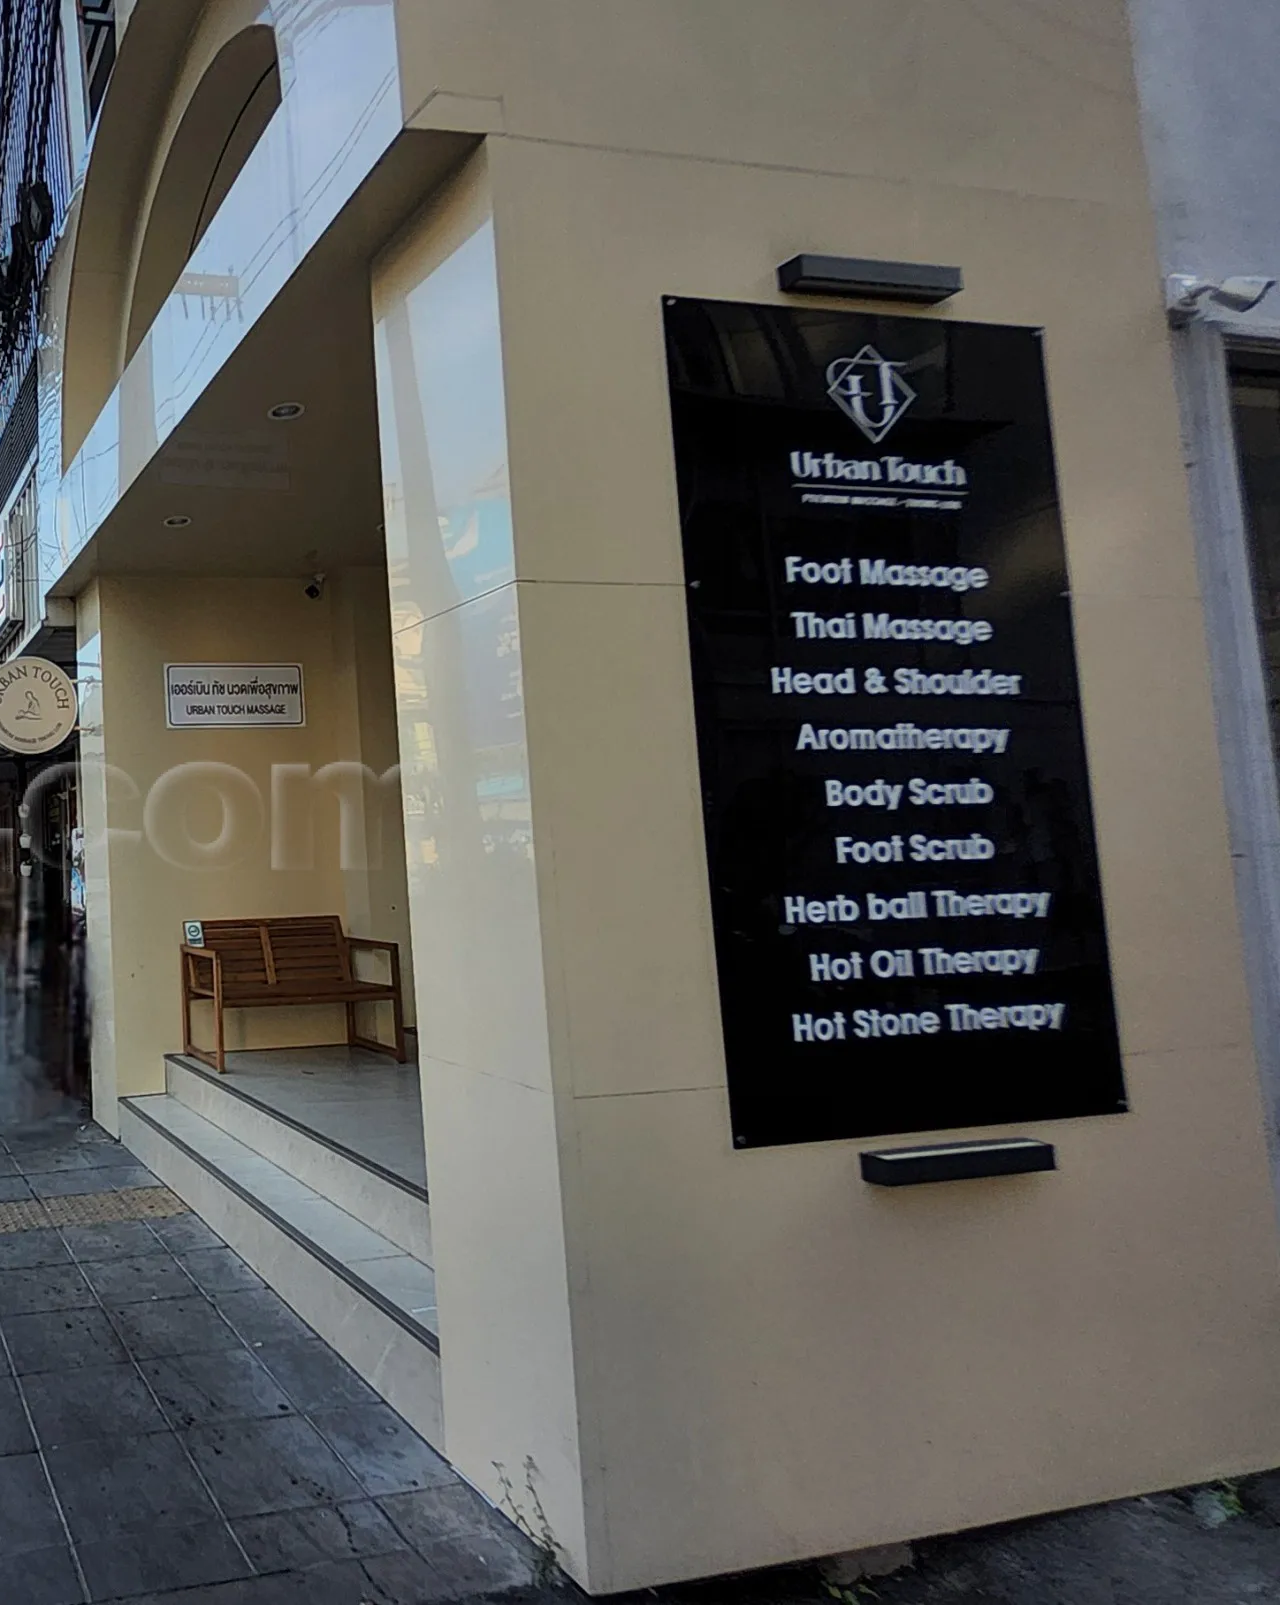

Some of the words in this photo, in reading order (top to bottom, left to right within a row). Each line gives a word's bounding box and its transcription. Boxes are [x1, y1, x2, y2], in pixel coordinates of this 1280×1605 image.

[790, 451, 882, 480] Urban
[880, 456, 966, 485] Touch
[785, 556, 852, 584] Foot
[859, 558, 989, 592] Massage
[790, 611, 857, 639] Thai
[863, 613, 993, 644] Massage
[32, 665, 70, 709] TOUCH
[171, 679, 210, 696] เออร์เบิน
[212, 680, 225, 696] ทัช
[227, 676, 298, 700] นวดเพื่อสุขภาพ
[771, 667, 855, 694] Head
[864, 668, 889, 694] &
[893, 668, 1022, 694] Shoulder
[186, 704, 216, 715] URBAN
[217, 704, 245, 715] TOUCH
[247, 704, 287, 715] MASSAGE
[796, 722, 1010, 754] Aromatherapy
[825, 779, 902, 810] Body
[908, 777, 994, 805] Scrub
[835, 836, 904, 863] Foot
[909, 834, 995, 861] Scrub
[784, 895, 860, 924] Herb
[867, 892, 928, 920] ball
[931, 890, 1052, 918] Therapy
[809, 952, 863, 981] Hot
[870, 950, 914, 978] Oil
[919, 947, 1040, 974] Therapy
[792, 1012, 846, 1042] Hot
[852, 1009, 941, 1038] Stone
[944, 1003, 1066, 1031] Therapy
